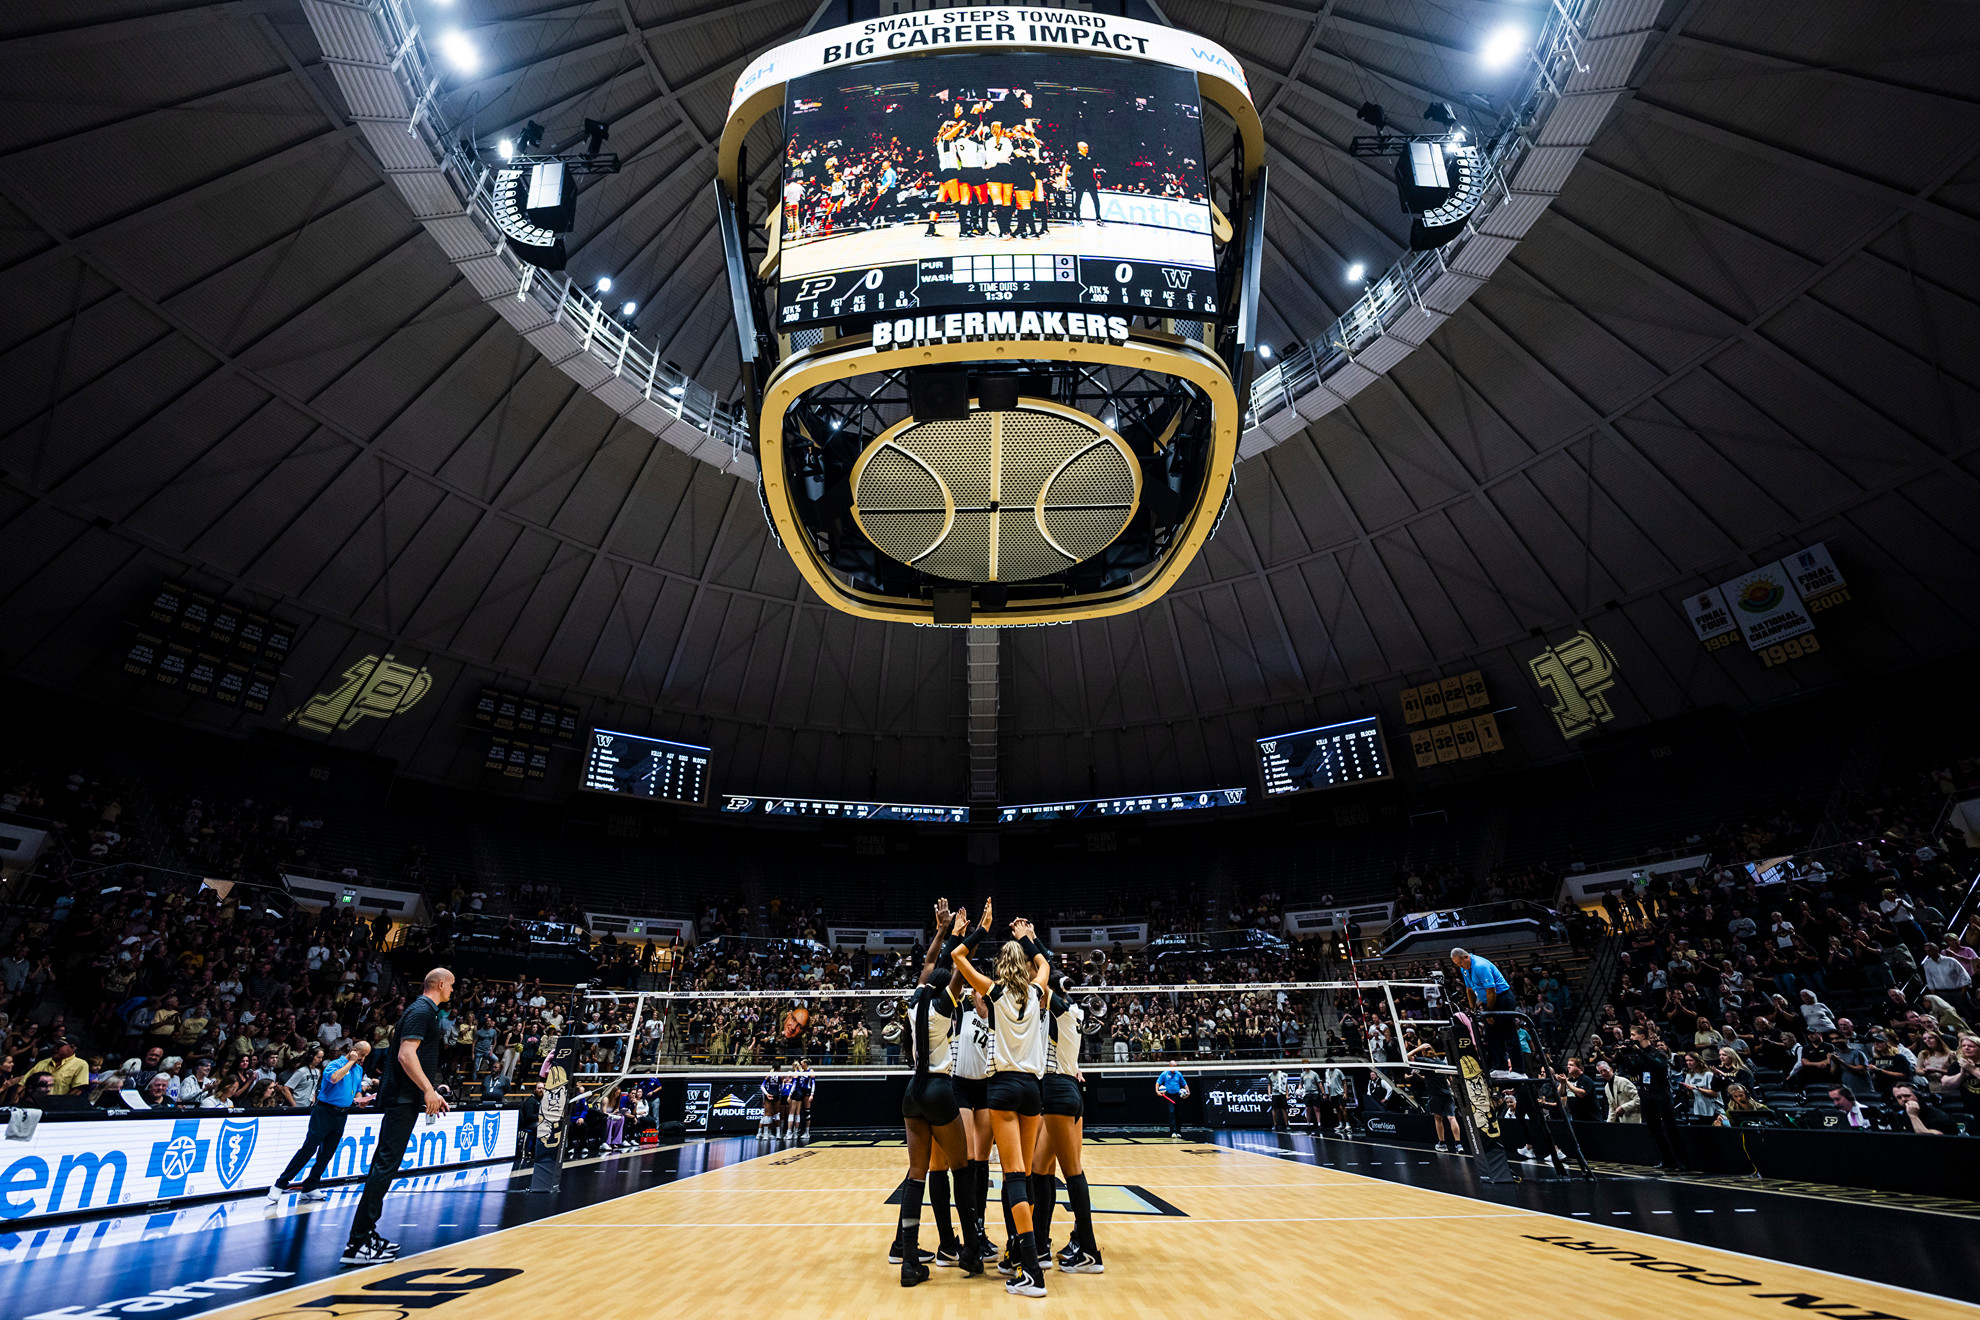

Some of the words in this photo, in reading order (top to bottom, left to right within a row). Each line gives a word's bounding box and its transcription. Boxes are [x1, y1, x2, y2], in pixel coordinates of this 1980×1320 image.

[864, 15, 933, 35] SMALL
[943, 10, 1008, 23] STEPS
[1017, 11, 1105, 28] TOWARD
[823, 38, 873, 65] BIG
[887, 24, 1016, 49] CAREER
[1029, 25, 1148, 54] IMPACT
[921, 261, 943, 269] PUR
[1061, 258, 1069, 266] 0
[865, 269, 884, 289] 0
[921, 273, 953, 283] WASH
[1061, 271, 1069, 279] 0
[1115, 263, 1132, 283] 0
[1161, 268, 1192, 290] W
[795, 275, 837, 302] P
[968, 284, 975, 292] 2
[979, 282, 998, 291] TIME
[999, 282, 1018, 291] OUTS
[1023, 282, 1030, 291] 2
[985, 291, 1013, 301] 1:30
[873, 311, 1129, 346] BOILERMAKERS
[1798, 565, 1834, 585] FINAL
[1804, 574, 1837, 593] FOUR
[1809, 588, 1852, 615] 2001
[1695, 608, 1726, 626] FINAL
[1749, 610, 1799, 633] NATIONAL
[1700, 616, 1729, 633] FOUR
[1749, 616, 1807, 642] CHAMPIONS
[1703, 631, 1741, 653] 1994
[1757, 633, 1821, 669] 1999
[1444, 687, 1463, 701] 22
[1466, 682, 1485, 696] 32
[1405, 698, 1420, 711] 41
[1424, 693, 1441, 706] 40
[1456, 731, 1476, 744] 50
[1484, 726, 1492, 738] 1
[596, 734, 614, 747] W
[1435, 736, 1454, 749] 32
[1260, 741, 1277, 754] W
[1414, 741, 1433, 754] 22
[1199, 794, 1208, 806] 0
[1224, 790, 1243, 804] W
[971, 1018, 990, 1033] BOILE
[972, 1029, 989, 1049] 14
[1459, 1038, 1470, 1048] P
[556, 1048, 572, 1059] P
[687, 1090, 701, 1100] W
[703, 1090, 709, 1099] 0
[1226, 1091, 1272, 1102] Francisc
[713, 1108, 745, 1117] PURDUE
[746, 1108, 765, 1116] FEDE
[1228, 1104, 1261, 1113] HEALTH
[1288, 1107, 1300, 1117] P
[683, 1114, 697, 1123] P
[699, 1117, 706, 1125] 0
[1823, 1116, 1838, 1127] P
[0, 1150, 128, 1220] em
[1522, 1235, 1762, 1287] COURT
